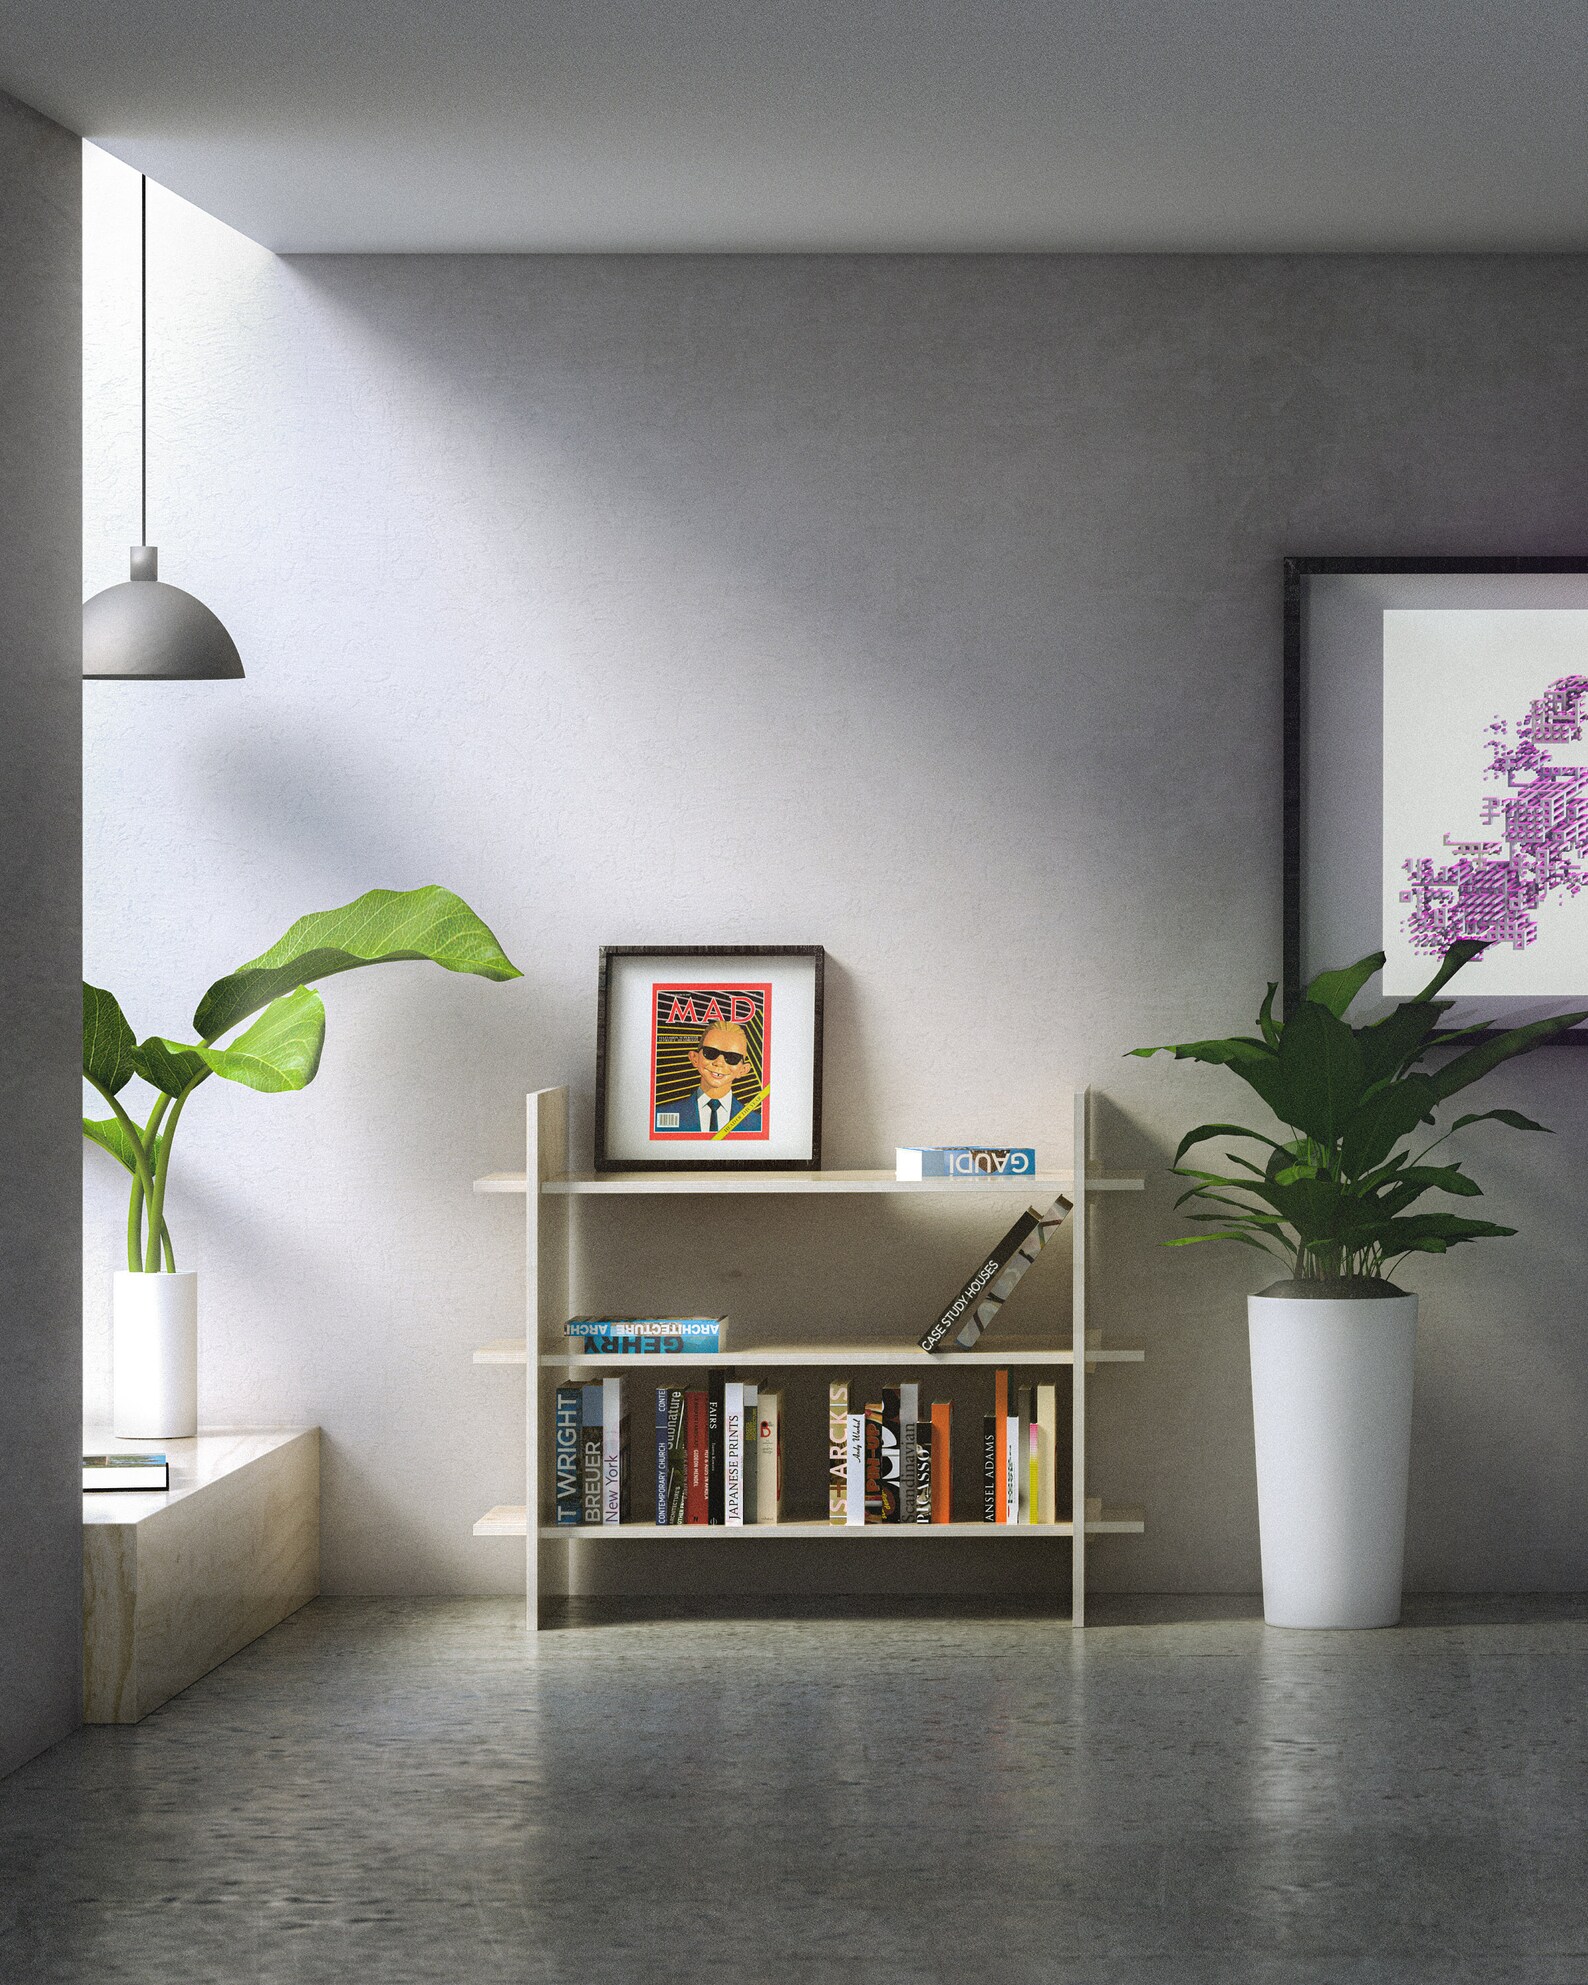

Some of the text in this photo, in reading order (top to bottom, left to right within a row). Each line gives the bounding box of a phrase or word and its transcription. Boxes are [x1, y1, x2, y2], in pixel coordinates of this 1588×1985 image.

[666, 996, 757, 1023] MAD
[950, 1152, 1029, 1174] GAUDI
[564, 1323, 720, 1335] ARCHITECTURE ARCHI
[922, 1259, 999, 1351] CASE STUDY HOUSES
[584, 1336, 684, 1354] GEHRY
[557, 1394, 577, 1498] WRIGHT
[709, 1402, 718, 1429] FAIRS
[852, 1418, 862, 1463] Andy Warhol
[585, 1441, 601, 1522] BREUER
[604, 1455, 618, 1522] New York
[658, 1442, 666, 1469] CHURCH
[729, 1415, 739, 1519] JAPANESE PRINTS
[866, 1423, 880, 1492] PIN-UP
[901, 1422, 916, 1523] Scandinavian
[916, 1449, 930, 1523] PICASSO
[984, 1434, 995, 1522] ANSEL ADAMS
[658, 1470, 666, 1524] CONTEMPORARY
